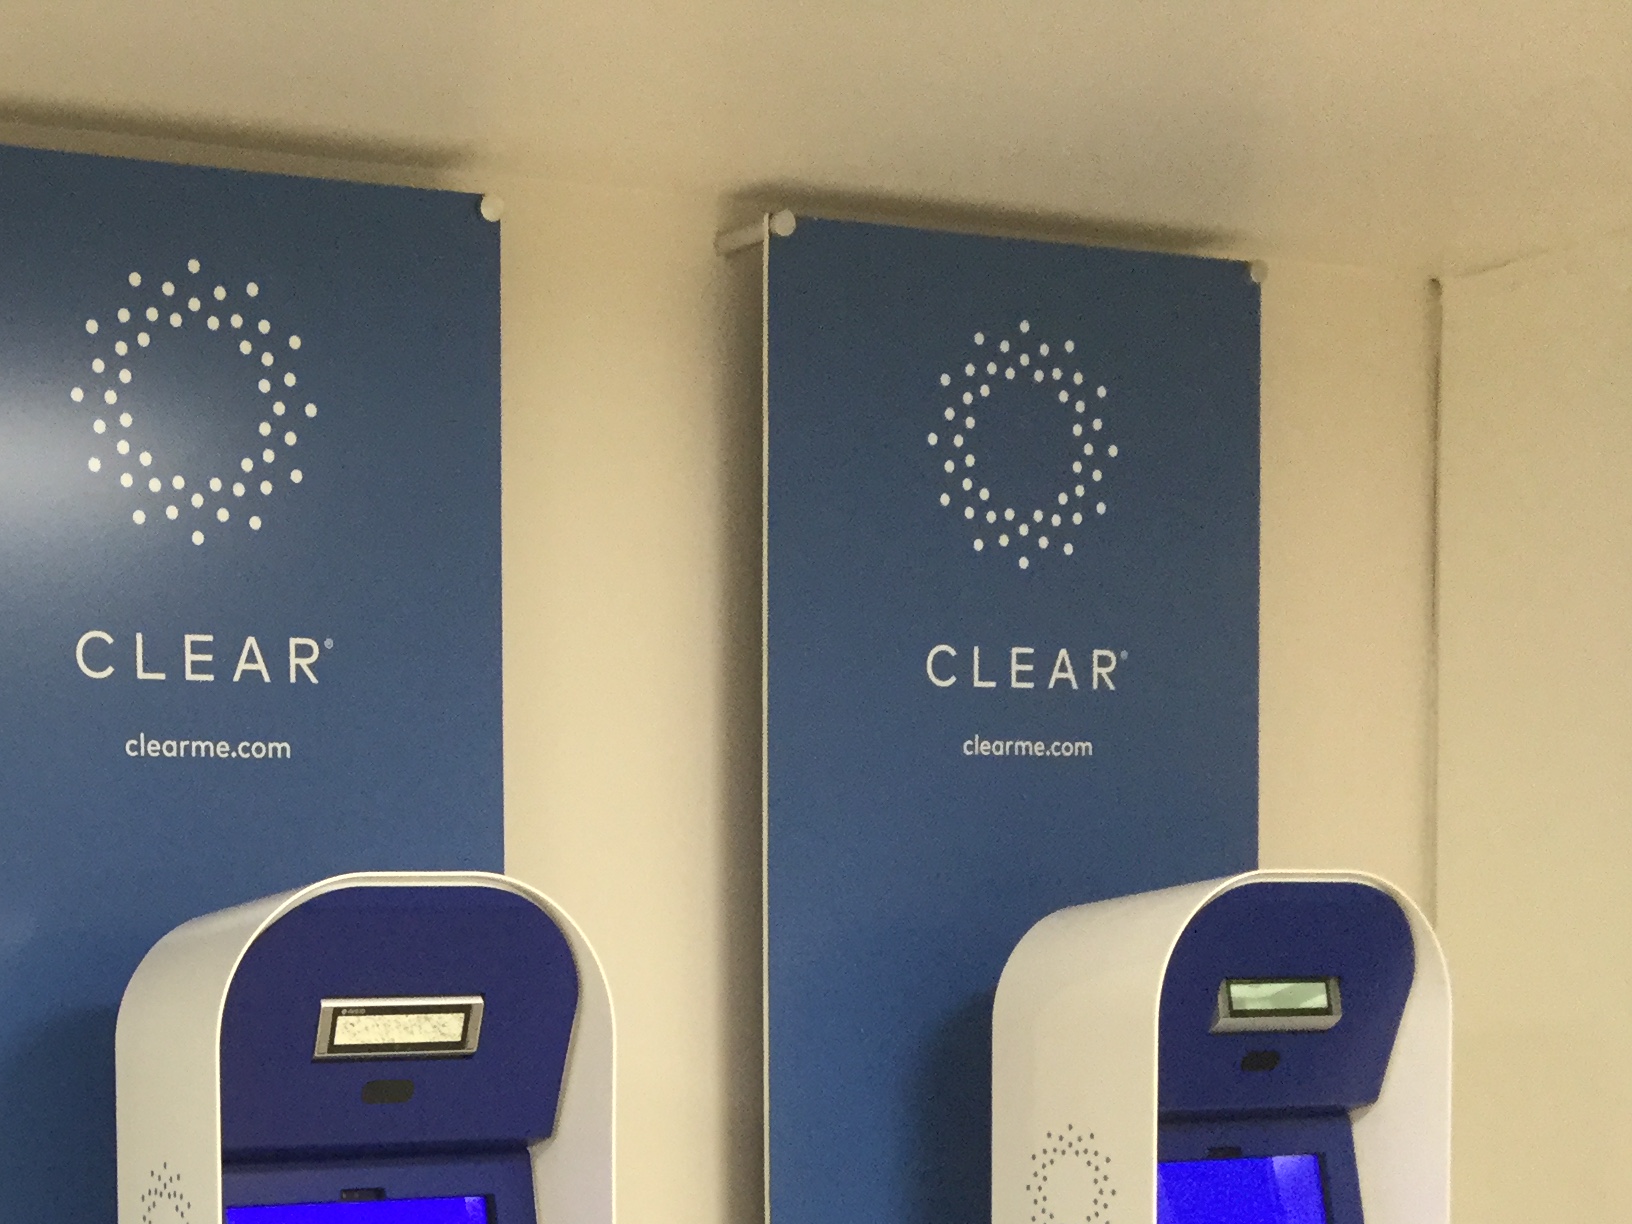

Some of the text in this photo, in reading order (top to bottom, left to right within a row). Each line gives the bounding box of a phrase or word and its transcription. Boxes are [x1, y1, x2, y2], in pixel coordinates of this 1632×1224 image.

[75, 629, 320, 684] CLEAR
[925, 644, 1117, 691] CLEAR
[124, 732, 292, 759] clearme.com
[962, 733, 1094, 757] clearme.com
